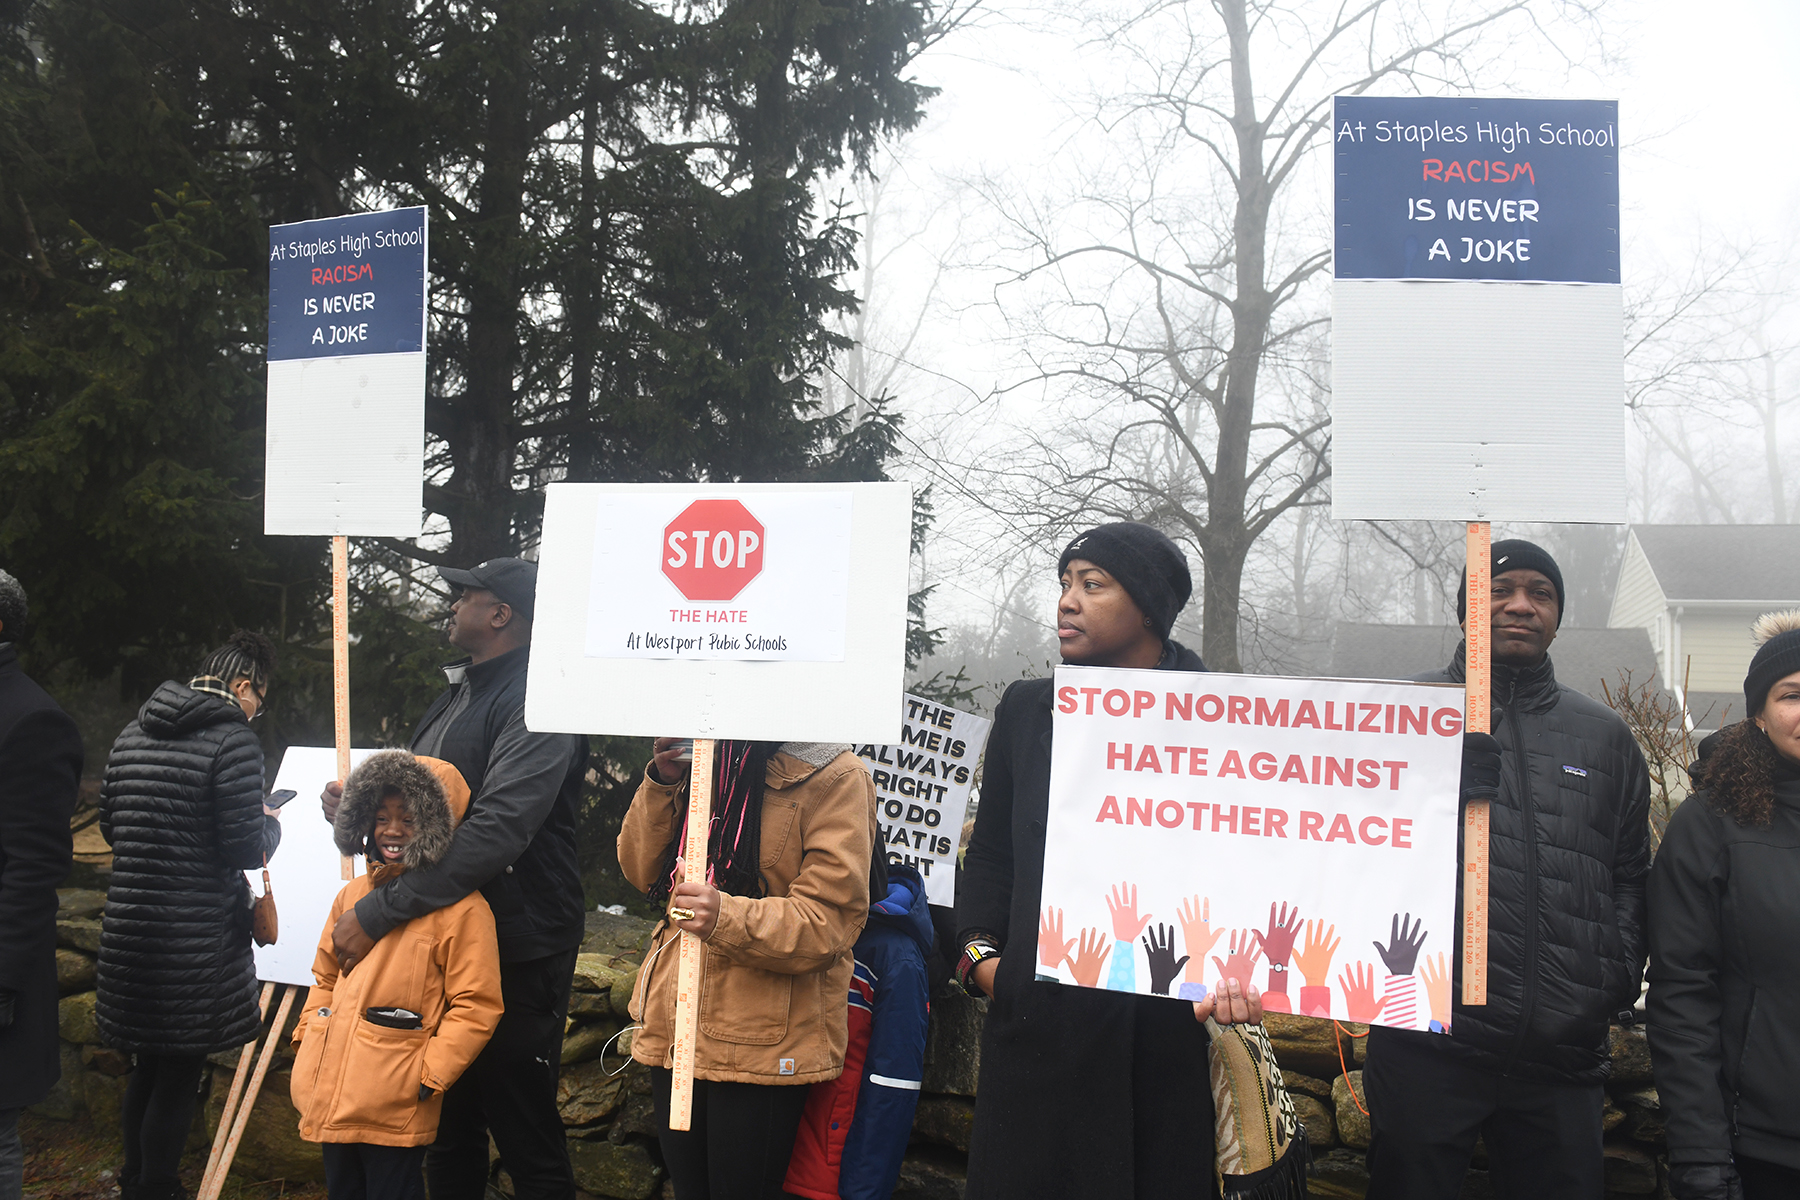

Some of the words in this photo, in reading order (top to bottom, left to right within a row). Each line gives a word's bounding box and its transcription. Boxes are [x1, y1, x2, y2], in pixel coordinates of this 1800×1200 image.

[1337, 121, 1366, 143] At
[1375, 120, 1468, 151] Staples
[1477, 122, 1530, 153] High
[1539, 123, 1614, 147] School
[1422, 158, 1535, 185] RACISM
[1408, 198, 1436, 221] IS
[1447, 198, 1540, 222] NEVER
[270, 244, 286, 261] At
[289, 238, 336, 263] Staples
[340, 232, 370, 258] High
[375, 226, 422, 248] School
[1428, 238, 1450, 261] A
[1460, 237, 1531, 263] JOKE
[312, 263, 373, 286] RACISM
[304, 298, 318, 315] IS
[323, 292, 376, 314] NEVER
[312, 327, 324, 344] A
[328, 323, 368, 344] JOKE
[668, 530, 760, 568] STOP
[1470, 572, 1478, 595] THE
[670, 609, 701, 622] THE
[706, 610, 748, 623] HATE
[1470, 598, 1478, 631] HOME
[627, 632, 641, 650] At
[646, 632, 704, 654] Westport
[708, 633, 740, 650] Pubic
[744, 633, 787, 651] Schools
[1470, 635, 1478, 671] DEPOT
[908, 699, 955, 732] THE
[1057, 686, 1156, 718] STOP
[1165, 692, 1463, 738] NORMALIZING
[693, 749, 702, 778] HOME
[942, 737, 966, 760] IS
[856, 744, 969, 786] ALWAYS
[1106, 742, 1208, 777] HATE
[1217, 750, 1408, 791] AGAINST
[690, 781, 700, 815] DEPOT
[872, 769, 948, 805] RIGHT
[905, 804, 941, 829] DO
[1096, 795, 1289, 838] ANOTHER
[1299, 811, 1413, 849] RACE
[880, 825, 927, 851] HAT
[929, 835, 951, 857] IS
[687, 863, 694, 876] OF
